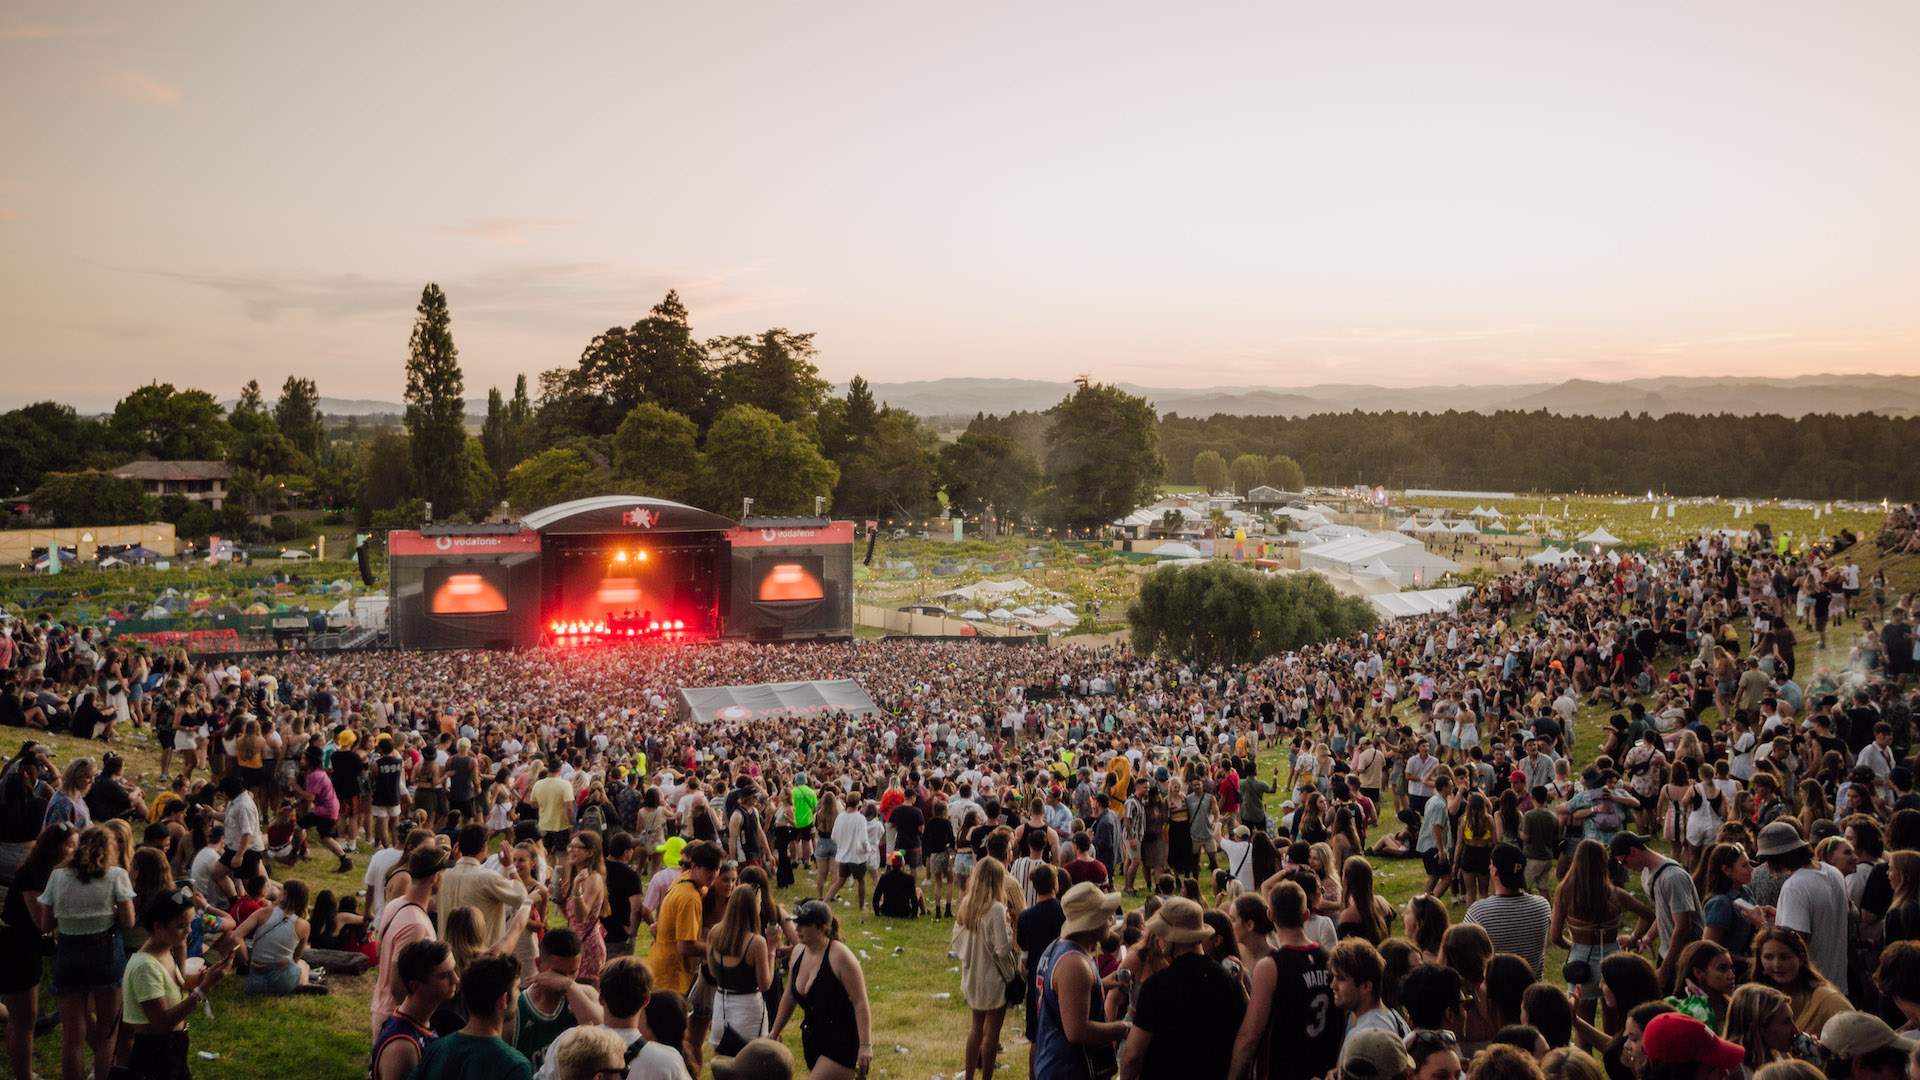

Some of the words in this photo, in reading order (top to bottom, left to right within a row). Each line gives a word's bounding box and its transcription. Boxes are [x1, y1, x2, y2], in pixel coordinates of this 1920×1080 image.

[454, 537, 497, 545] vodafone
[1302, 969, 1329, 988] WADE
[1306, 993, 1329, 1038] 3
